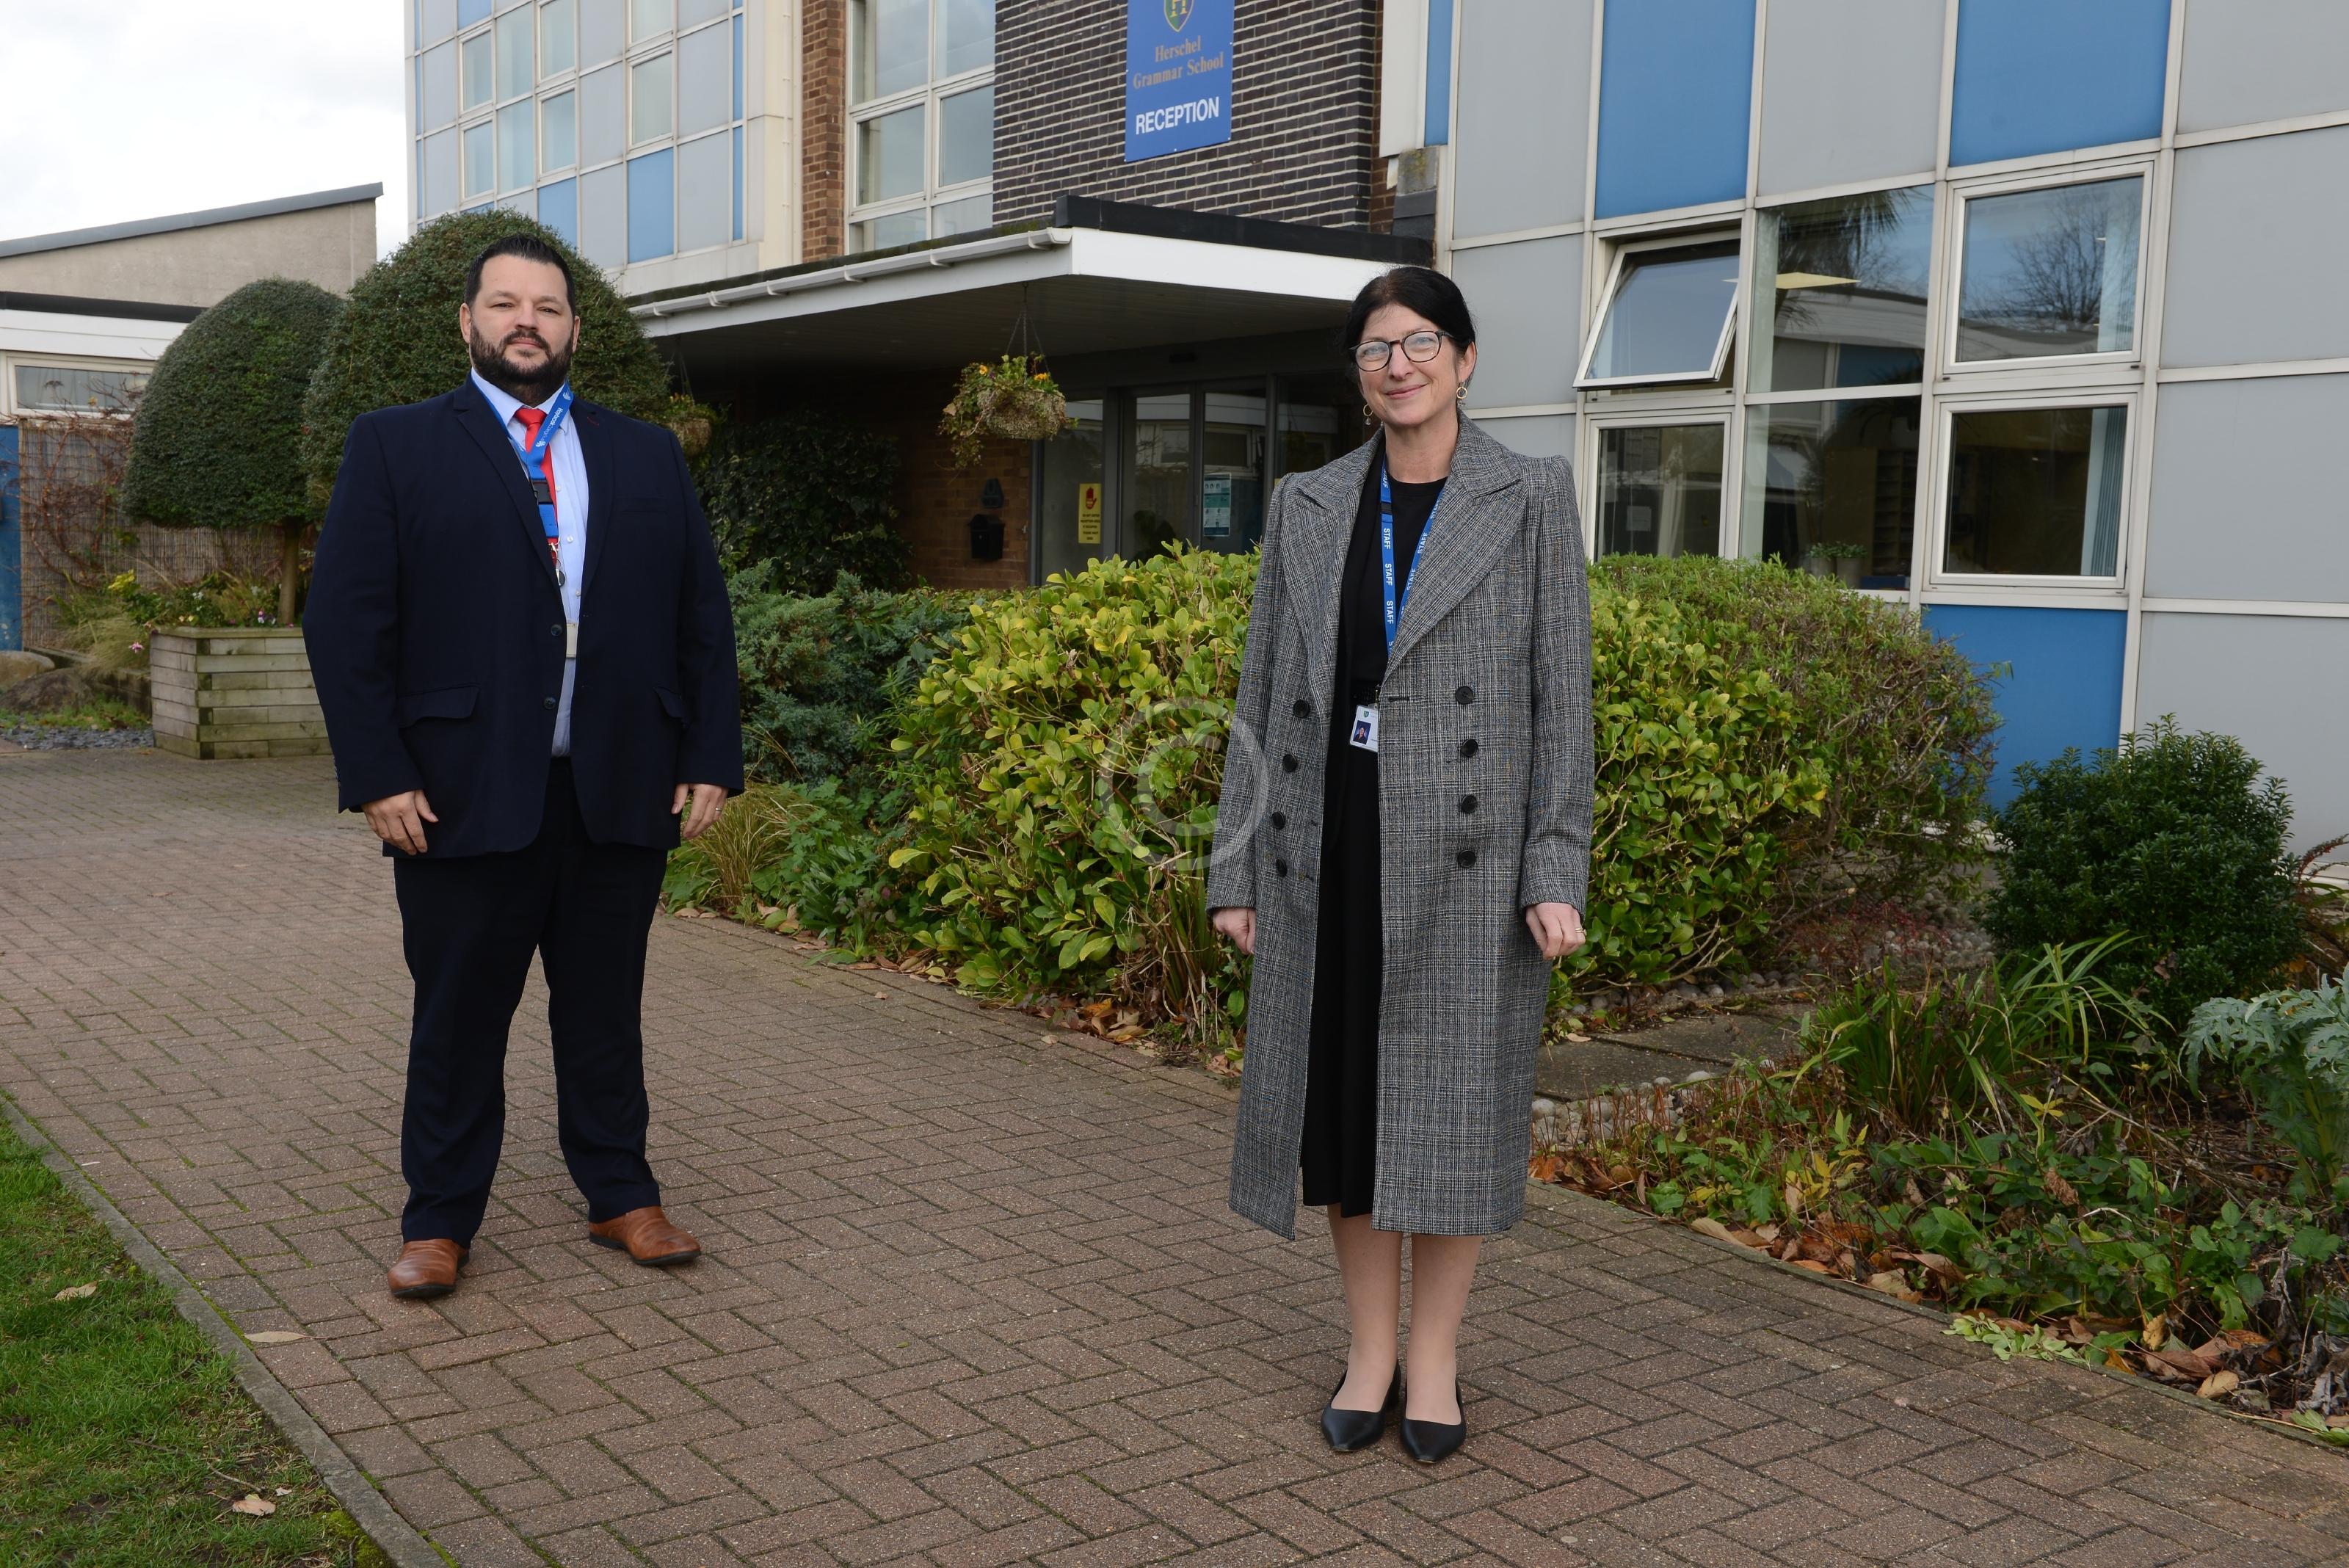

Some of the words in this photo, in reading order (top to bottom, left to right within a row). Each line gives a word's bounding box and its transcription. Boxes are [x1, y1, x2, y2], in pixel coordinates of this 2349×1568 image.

[1155, 35, 1202, 62] Herschel
[1133, 66, 1183, 89] Grammar
[1187, 51, 1224, 76] School
[1136, 96, 1219, 135] RECEPTION
[1383, 528, 1391, 550] STAFF
[1417, 532, 1428, 554] STAFF
[1384, 563, 1393, 586] STAFF
[1406, 567, 1416, 591] STAFF
[1386, 600, 1394, 624] STAFF
